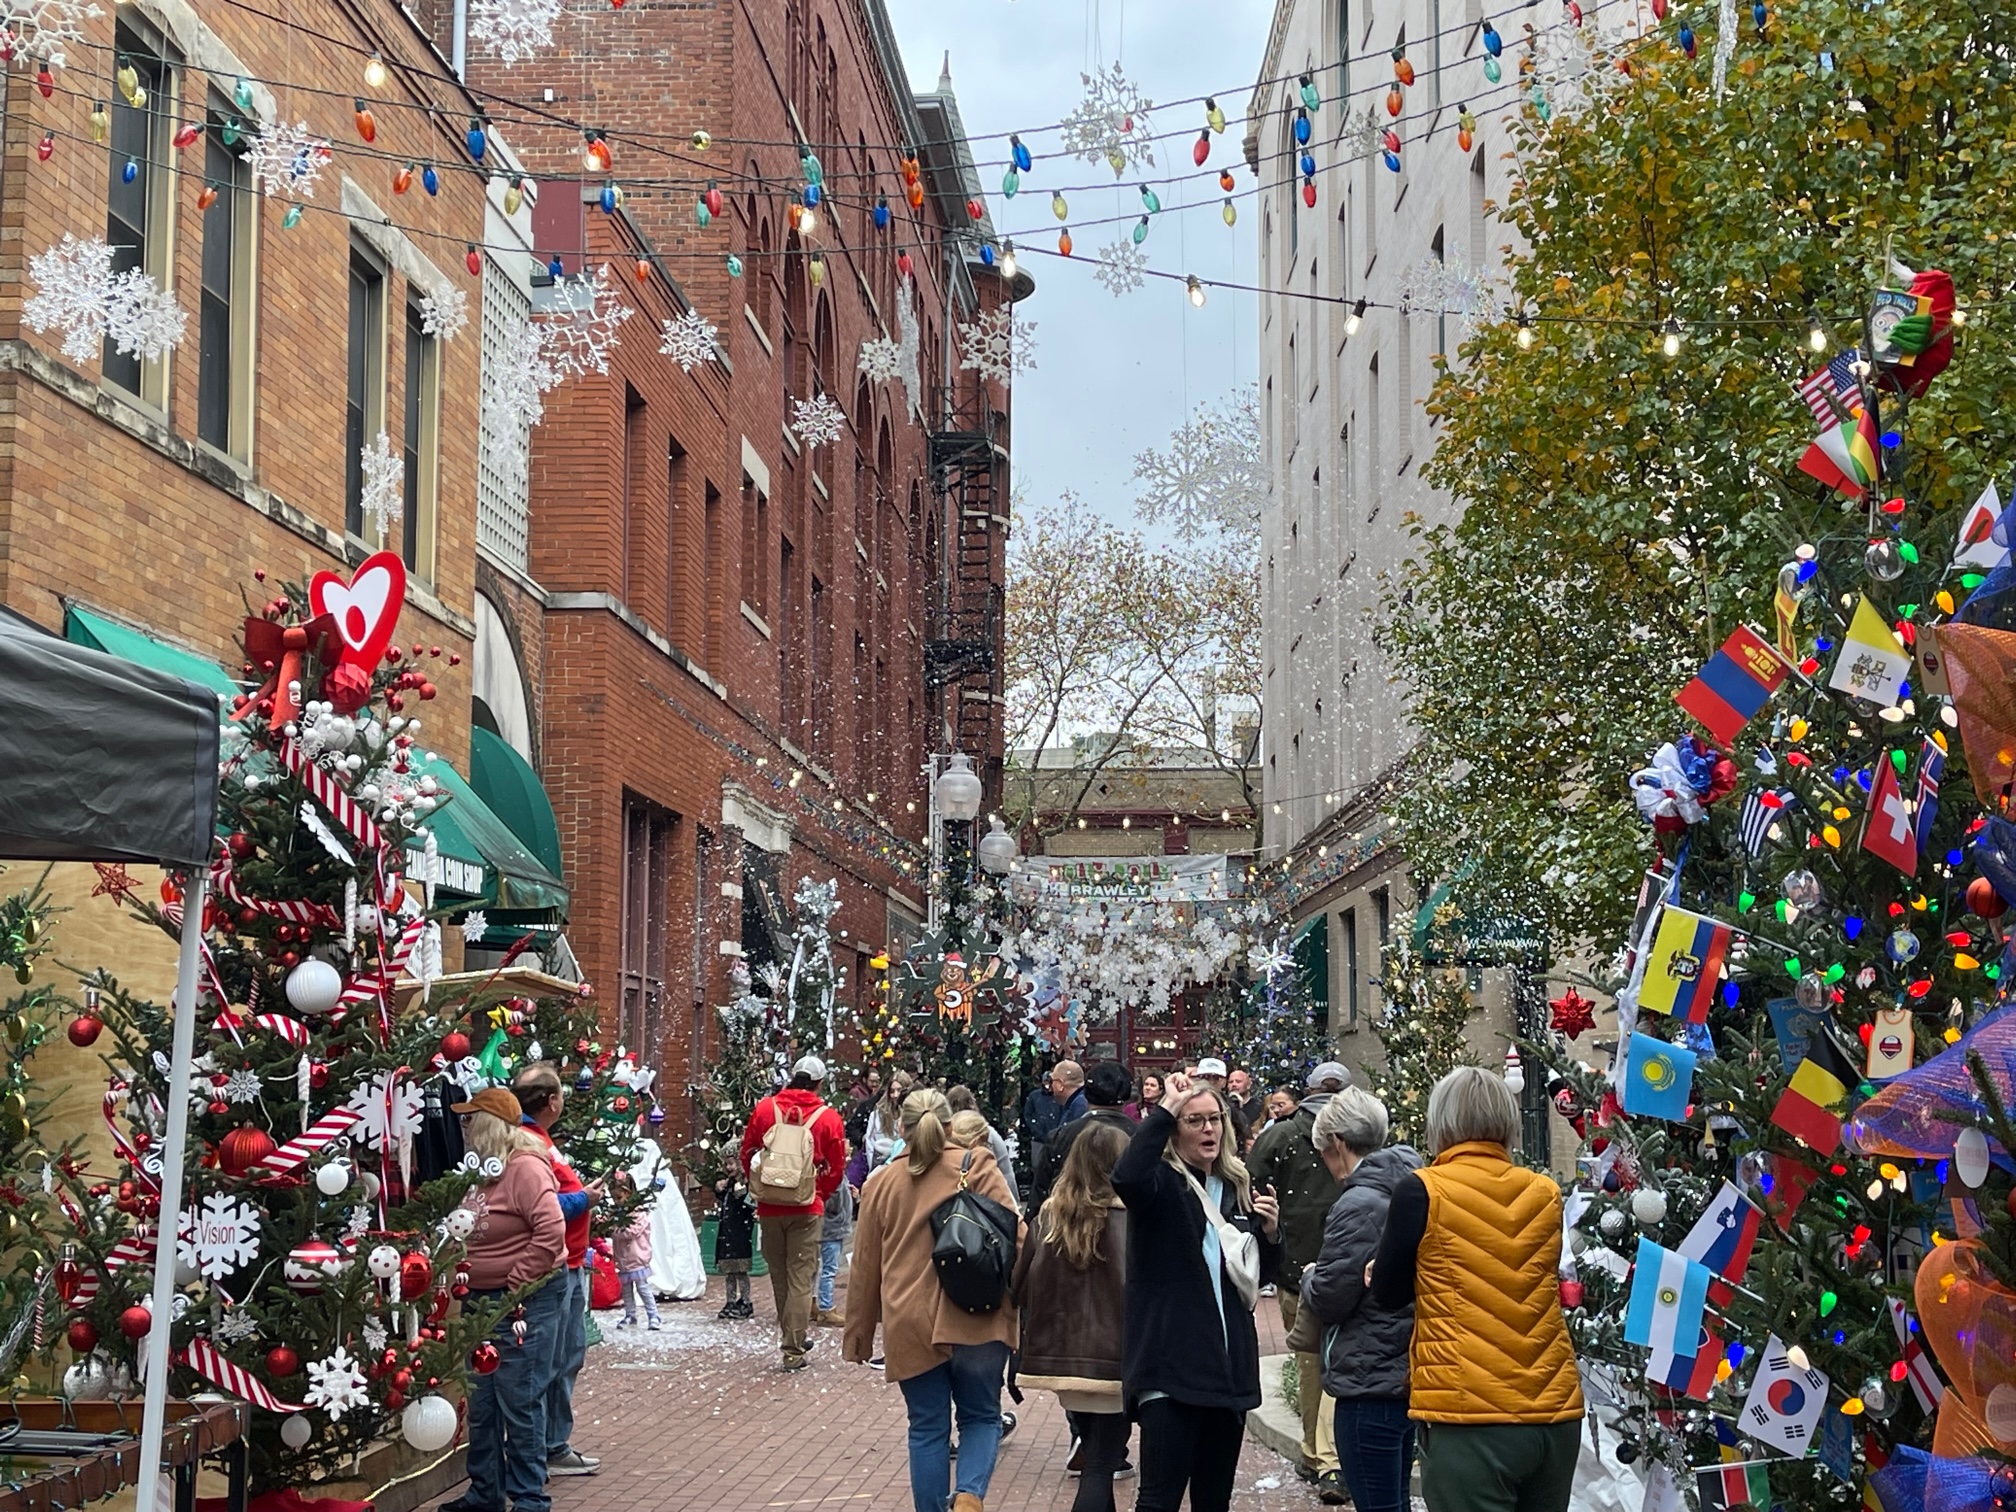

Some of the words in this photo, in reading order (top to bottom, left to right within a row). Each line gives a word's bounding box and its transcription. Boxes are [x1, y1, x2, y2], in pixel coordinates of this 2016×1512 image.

[445, 857, 463, 890] COIN
[464, 863, 483, 894] SHOP
[1071, 885, 1149, 896] BRAWLEY
[199, 1222, 235, 1245] Vision
